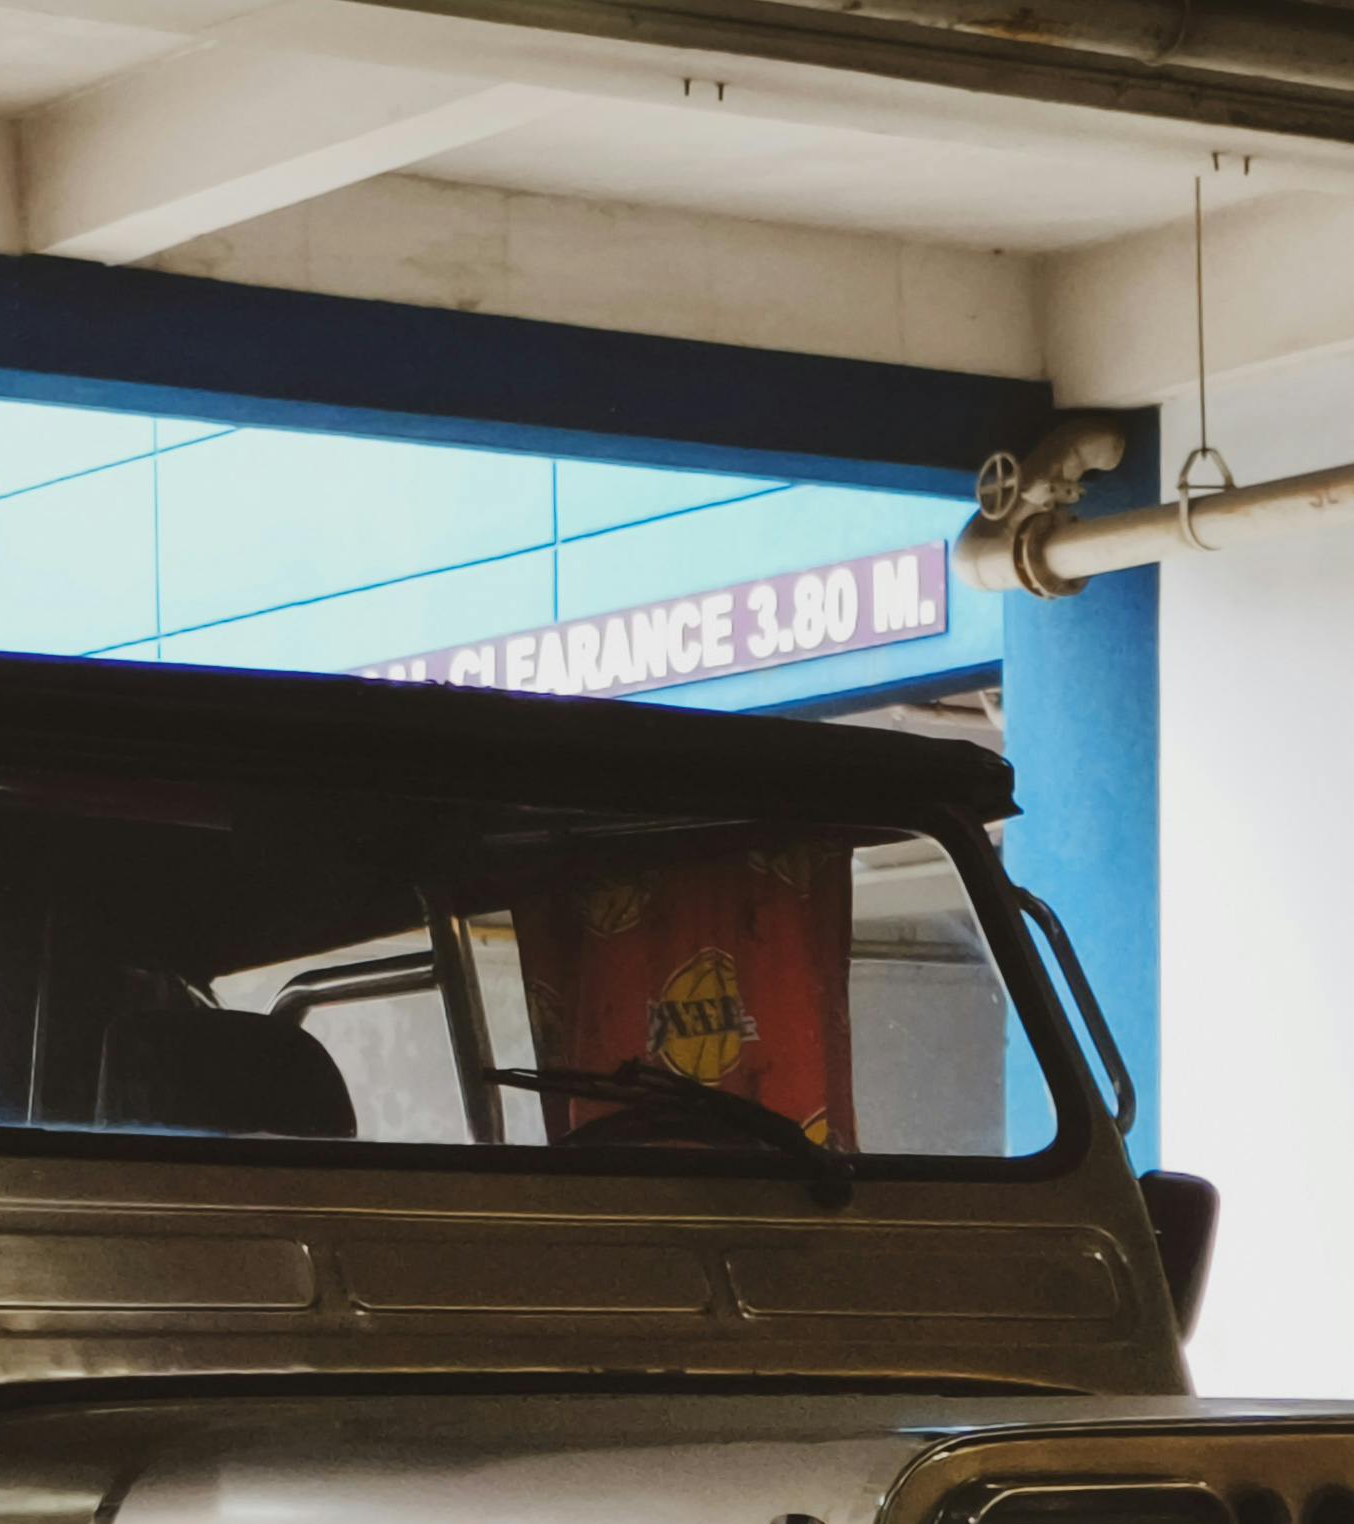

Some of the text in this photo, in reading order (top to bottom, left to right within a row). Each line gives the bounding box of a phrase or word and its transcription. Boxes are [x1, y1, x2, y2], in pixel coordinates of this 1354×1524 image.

[448, 553, 936, 695] CLEARANCE 3.80 M.
